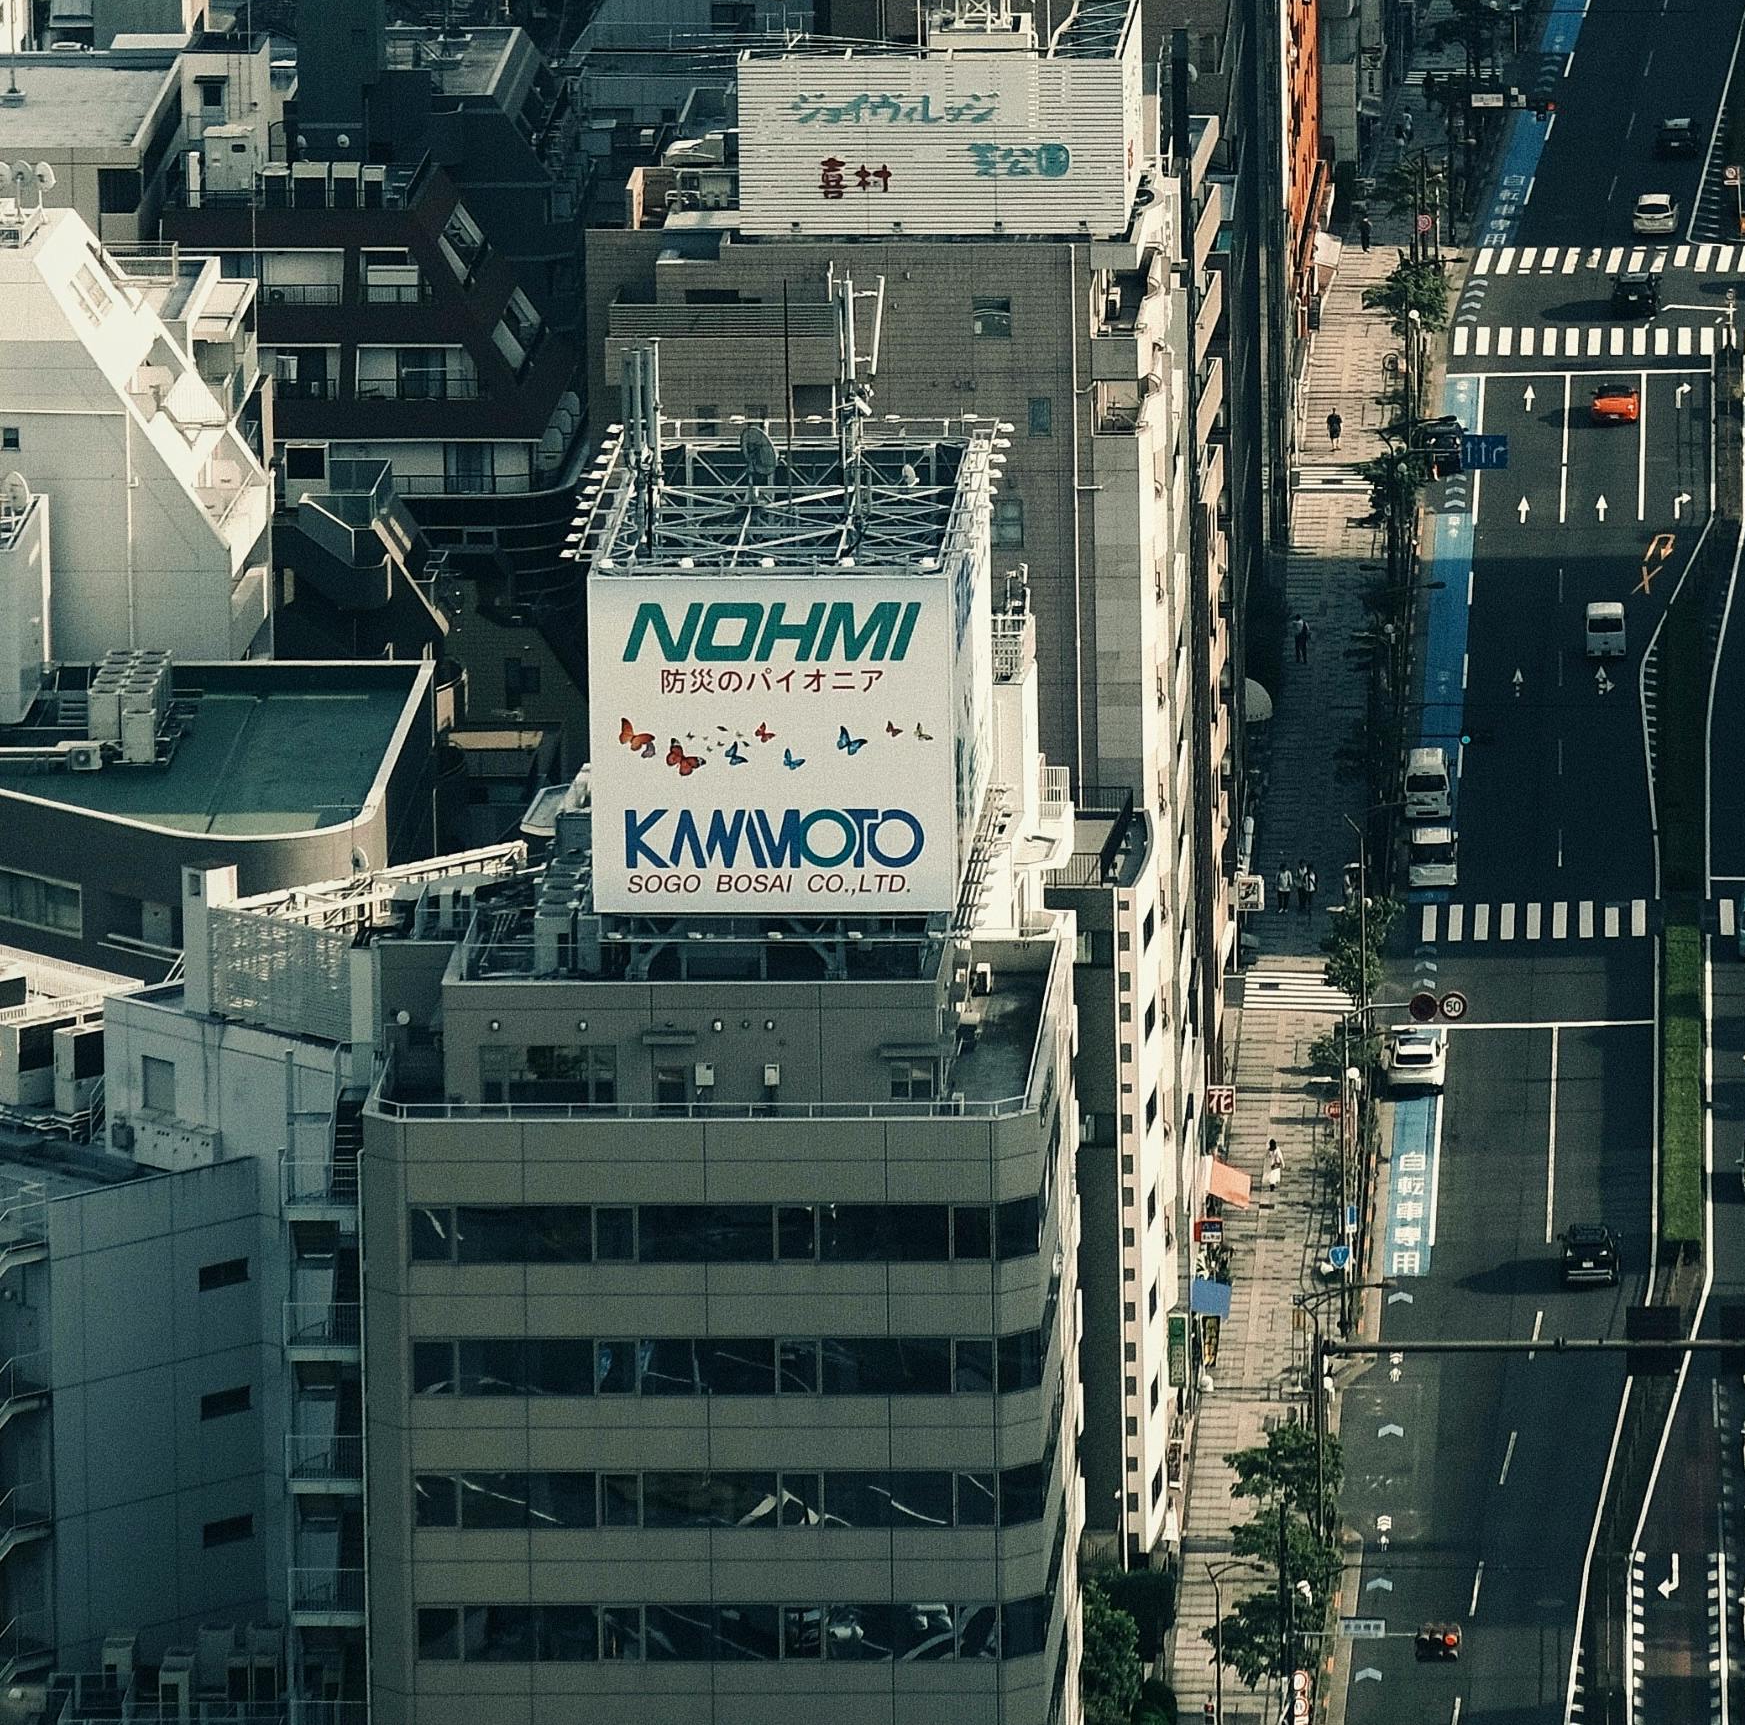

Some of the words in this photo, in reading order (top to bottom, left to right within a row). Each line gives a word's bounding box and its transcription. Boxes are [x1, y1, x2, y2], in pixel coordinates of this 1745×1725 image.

[623, 602, 922, 662] NOHMI
[660, 668, 884, 695] 防災のパイオニア
[627, 873, 701, 894] SOGO
[716, 874, 792, 894] BOSAI
[807, 873, 911, 896] CO.,LTD.
[1445, 999, 1461, 1013] 50
[1209, 1089, 1233, 1114] 花
[1392, 1152, 1426, 1274] 自転車専用
